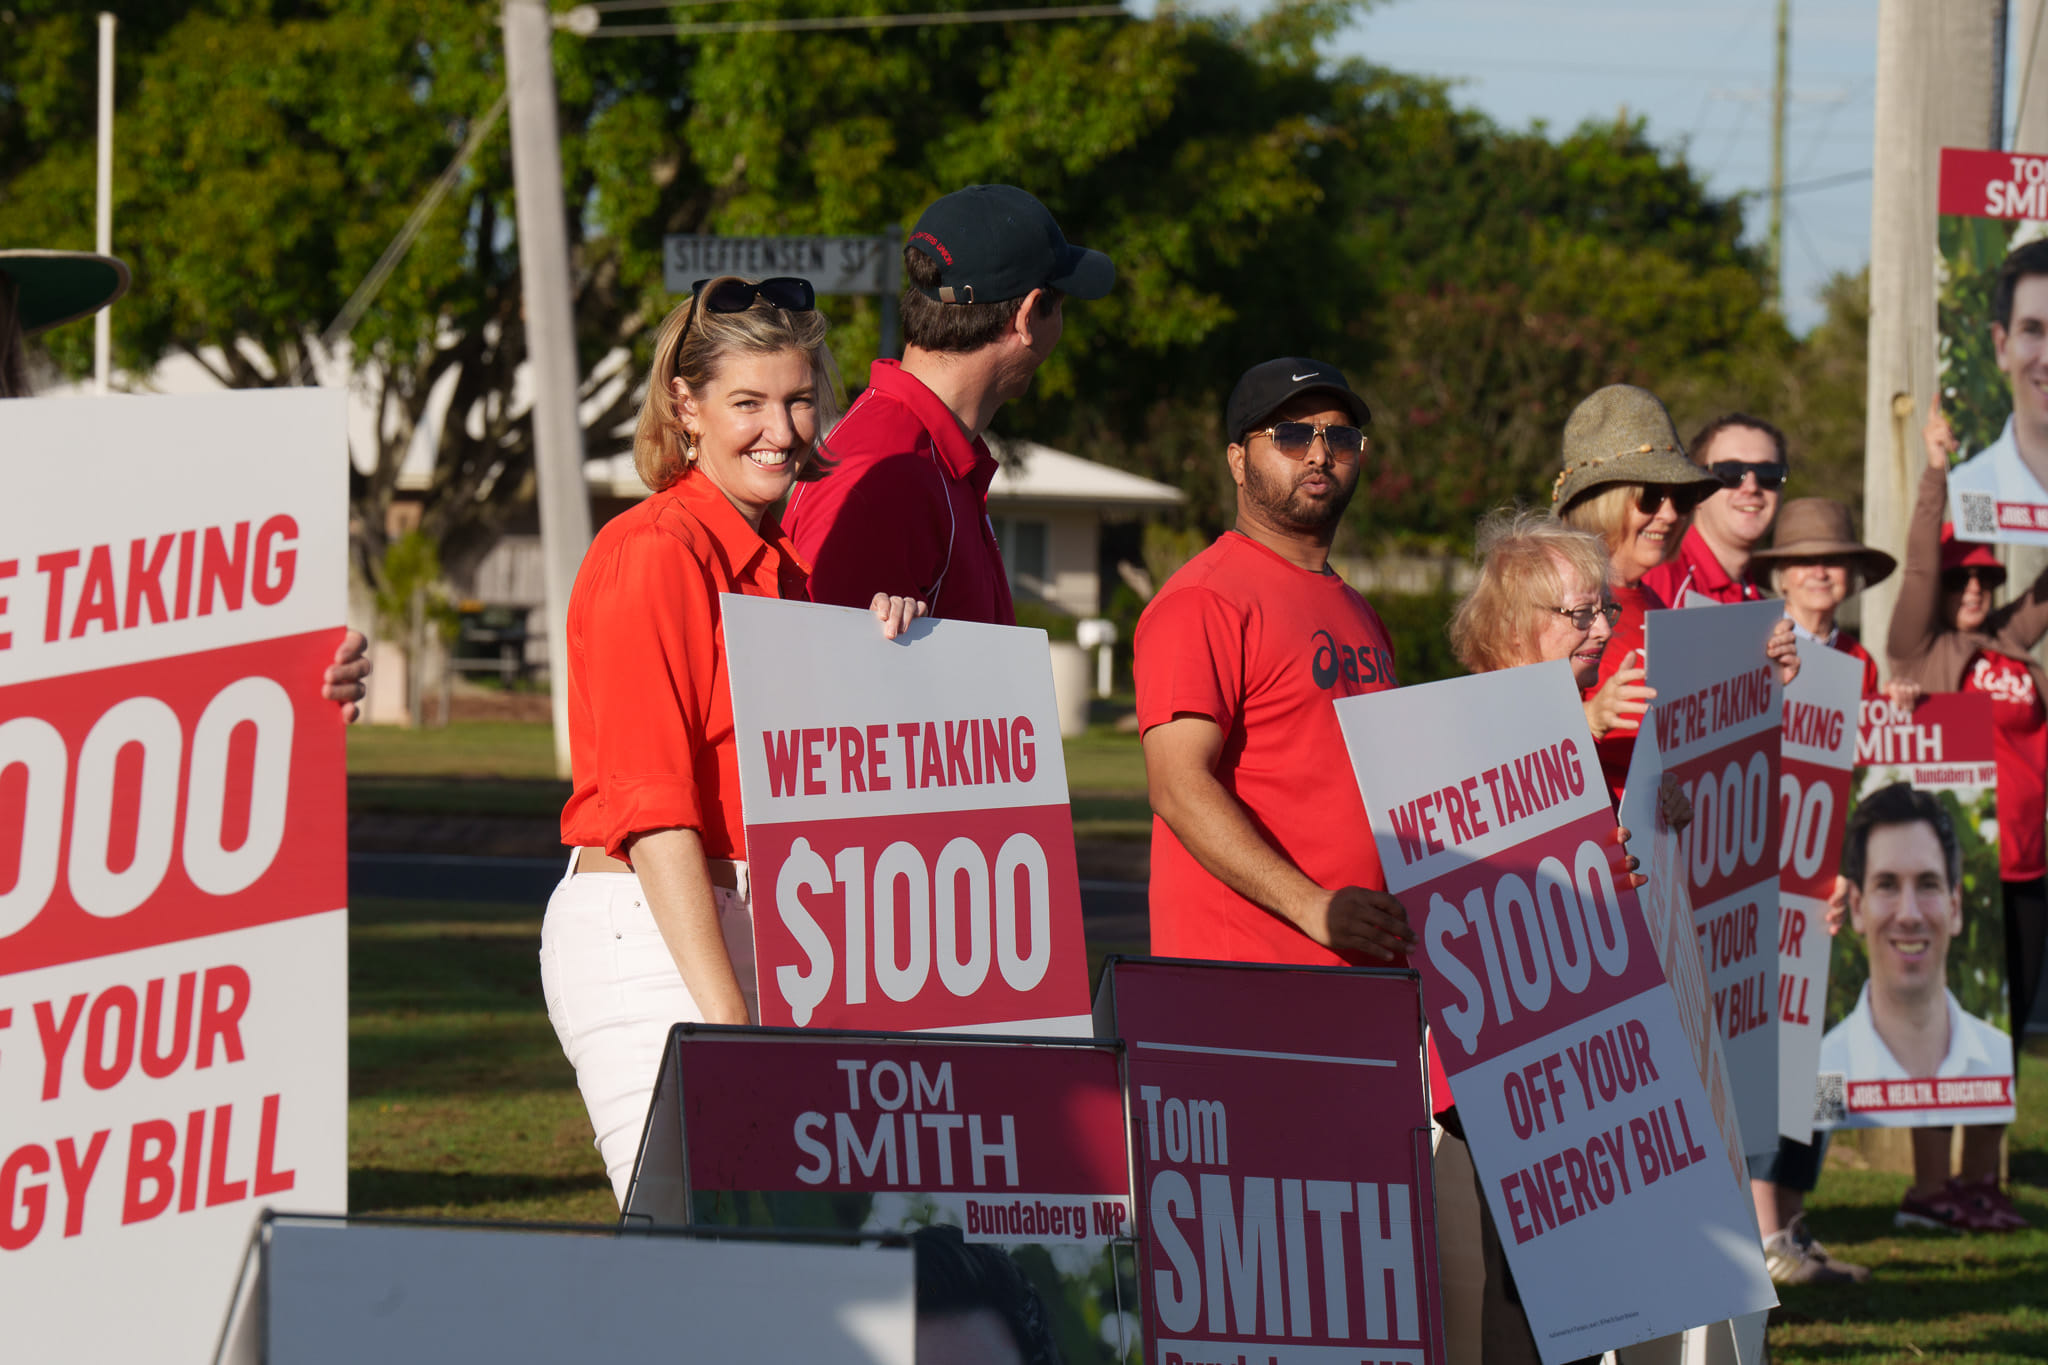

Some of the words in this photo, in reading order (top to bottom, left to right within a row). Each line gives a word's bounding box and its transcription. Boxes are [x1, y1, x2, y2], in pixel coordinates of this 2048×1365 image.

[1984, 178, 2048, 218] SMI
[2010, 157, 2048, 185] TO
[674, 237, 825, 275] STEFFENSEN
[36, 513, 300, 643] TAKING
[1711, 665, 1772, 734] TAKING
[1858, 698, 1913, 727] TOM
[763, 724, 892, 798] WE'RE
[897, 715, 1037, 790] TAKING
[1388, 779, 1490, 867] WE'RE
[1482, 738, 1585, 838] TAKING
[775, 832, 1051, 1028] $1000
[1424, 839, 1629, 1056] $1000
[1710, 902, 1759, 973] YOUR
[33, 964, 251, 1102] YOUR
[1728, 971, 1769, 1040] BILL
[836, 1058, 955, 1112] TOM
[1503, 1046, 1566, 1141] OFF
[1565, 1018, 1659, 1102] YOUR
[121, 1093, 296, 1227] BILL
[794, 1111, 1020, 1187] SMITH
[1141, 1085, 1229, 1166] Tom
[1500, 1124, 1633, 1245] ENERGY
[1627, 1098, 1707, 1187] BILL
[966, 1200, 1087, 1240] Bundaberg
[1092, 1201, 1127, 1237] MP
[1150, 1169, 1420, 1342] SMITH
